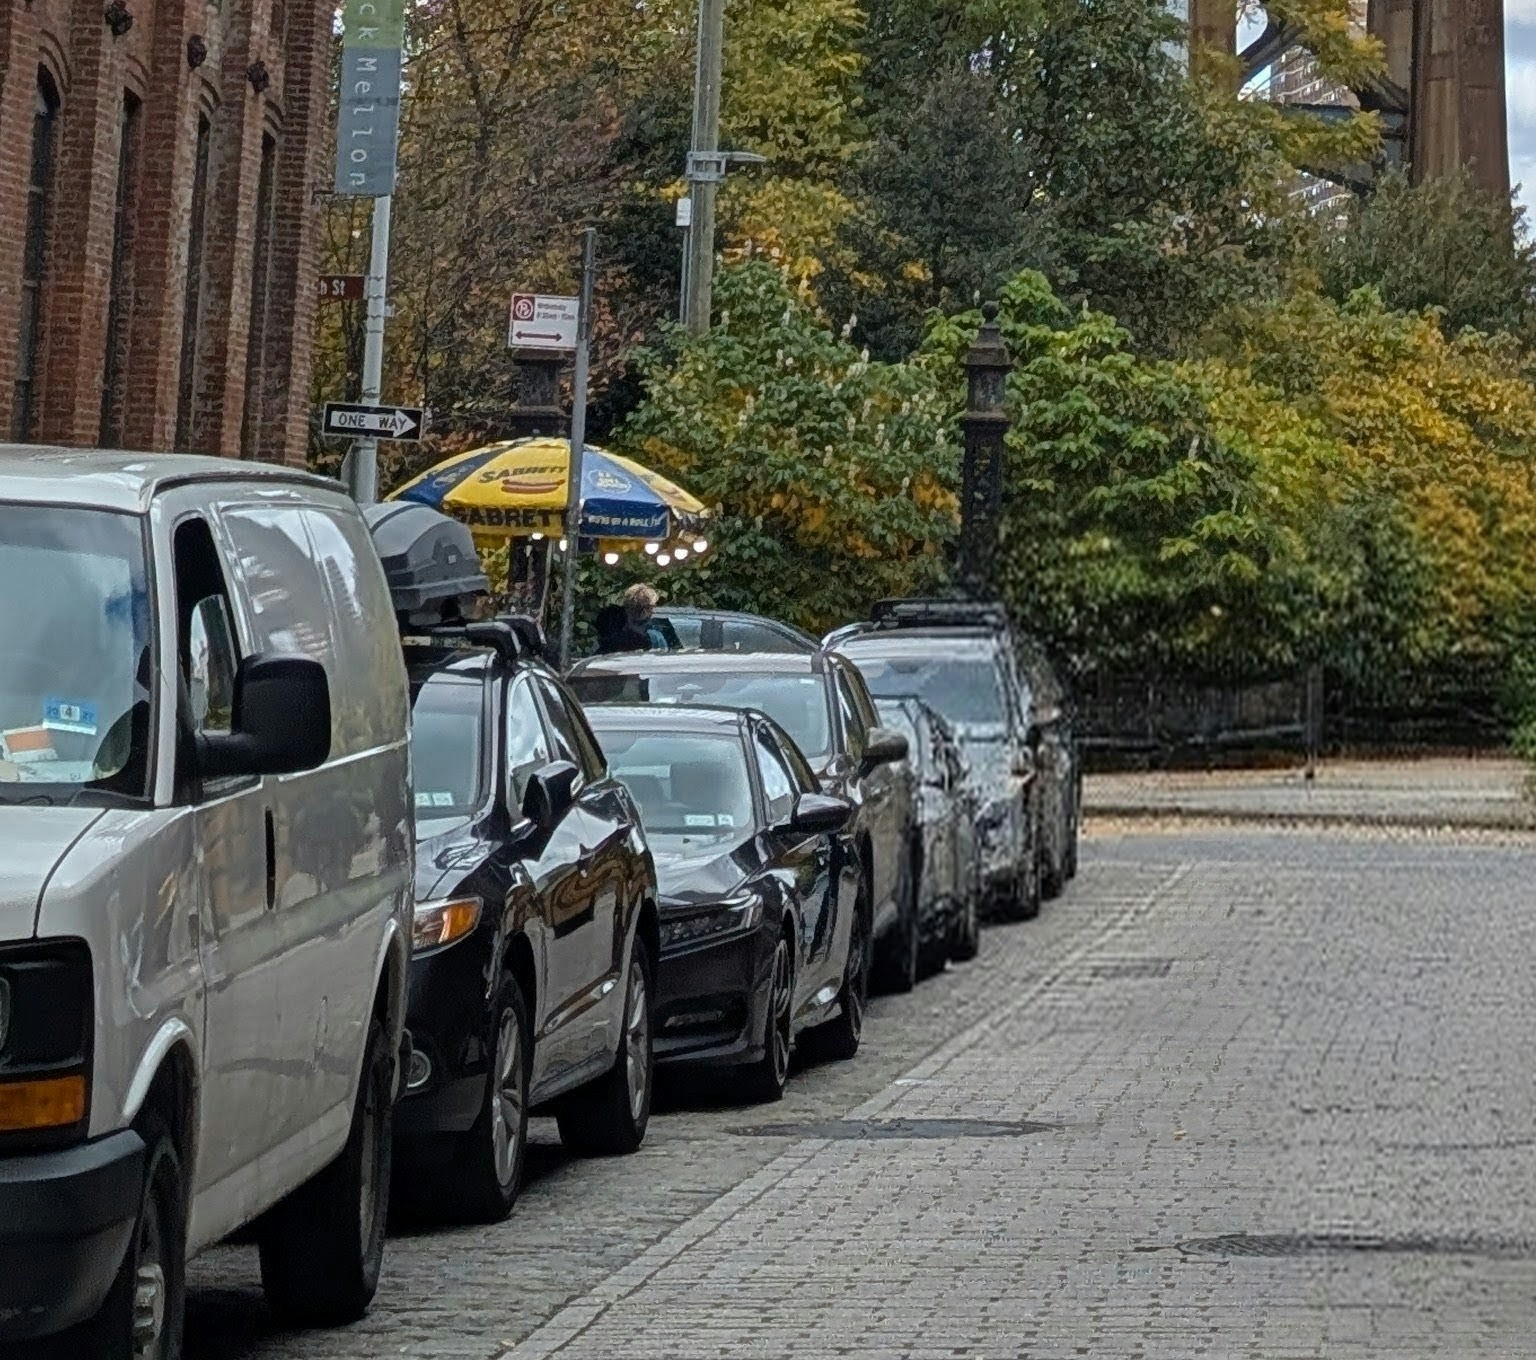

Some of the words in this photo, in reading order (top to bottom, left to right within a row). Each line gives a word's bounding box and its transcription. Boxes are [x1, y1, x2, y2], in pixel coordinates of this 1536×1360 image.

[350, 57, 378, 186] Mellon
[332, 280, 346, 296] St
[338, 413, 366, 428] ONE
[378, 416, 408, 431] WAY
